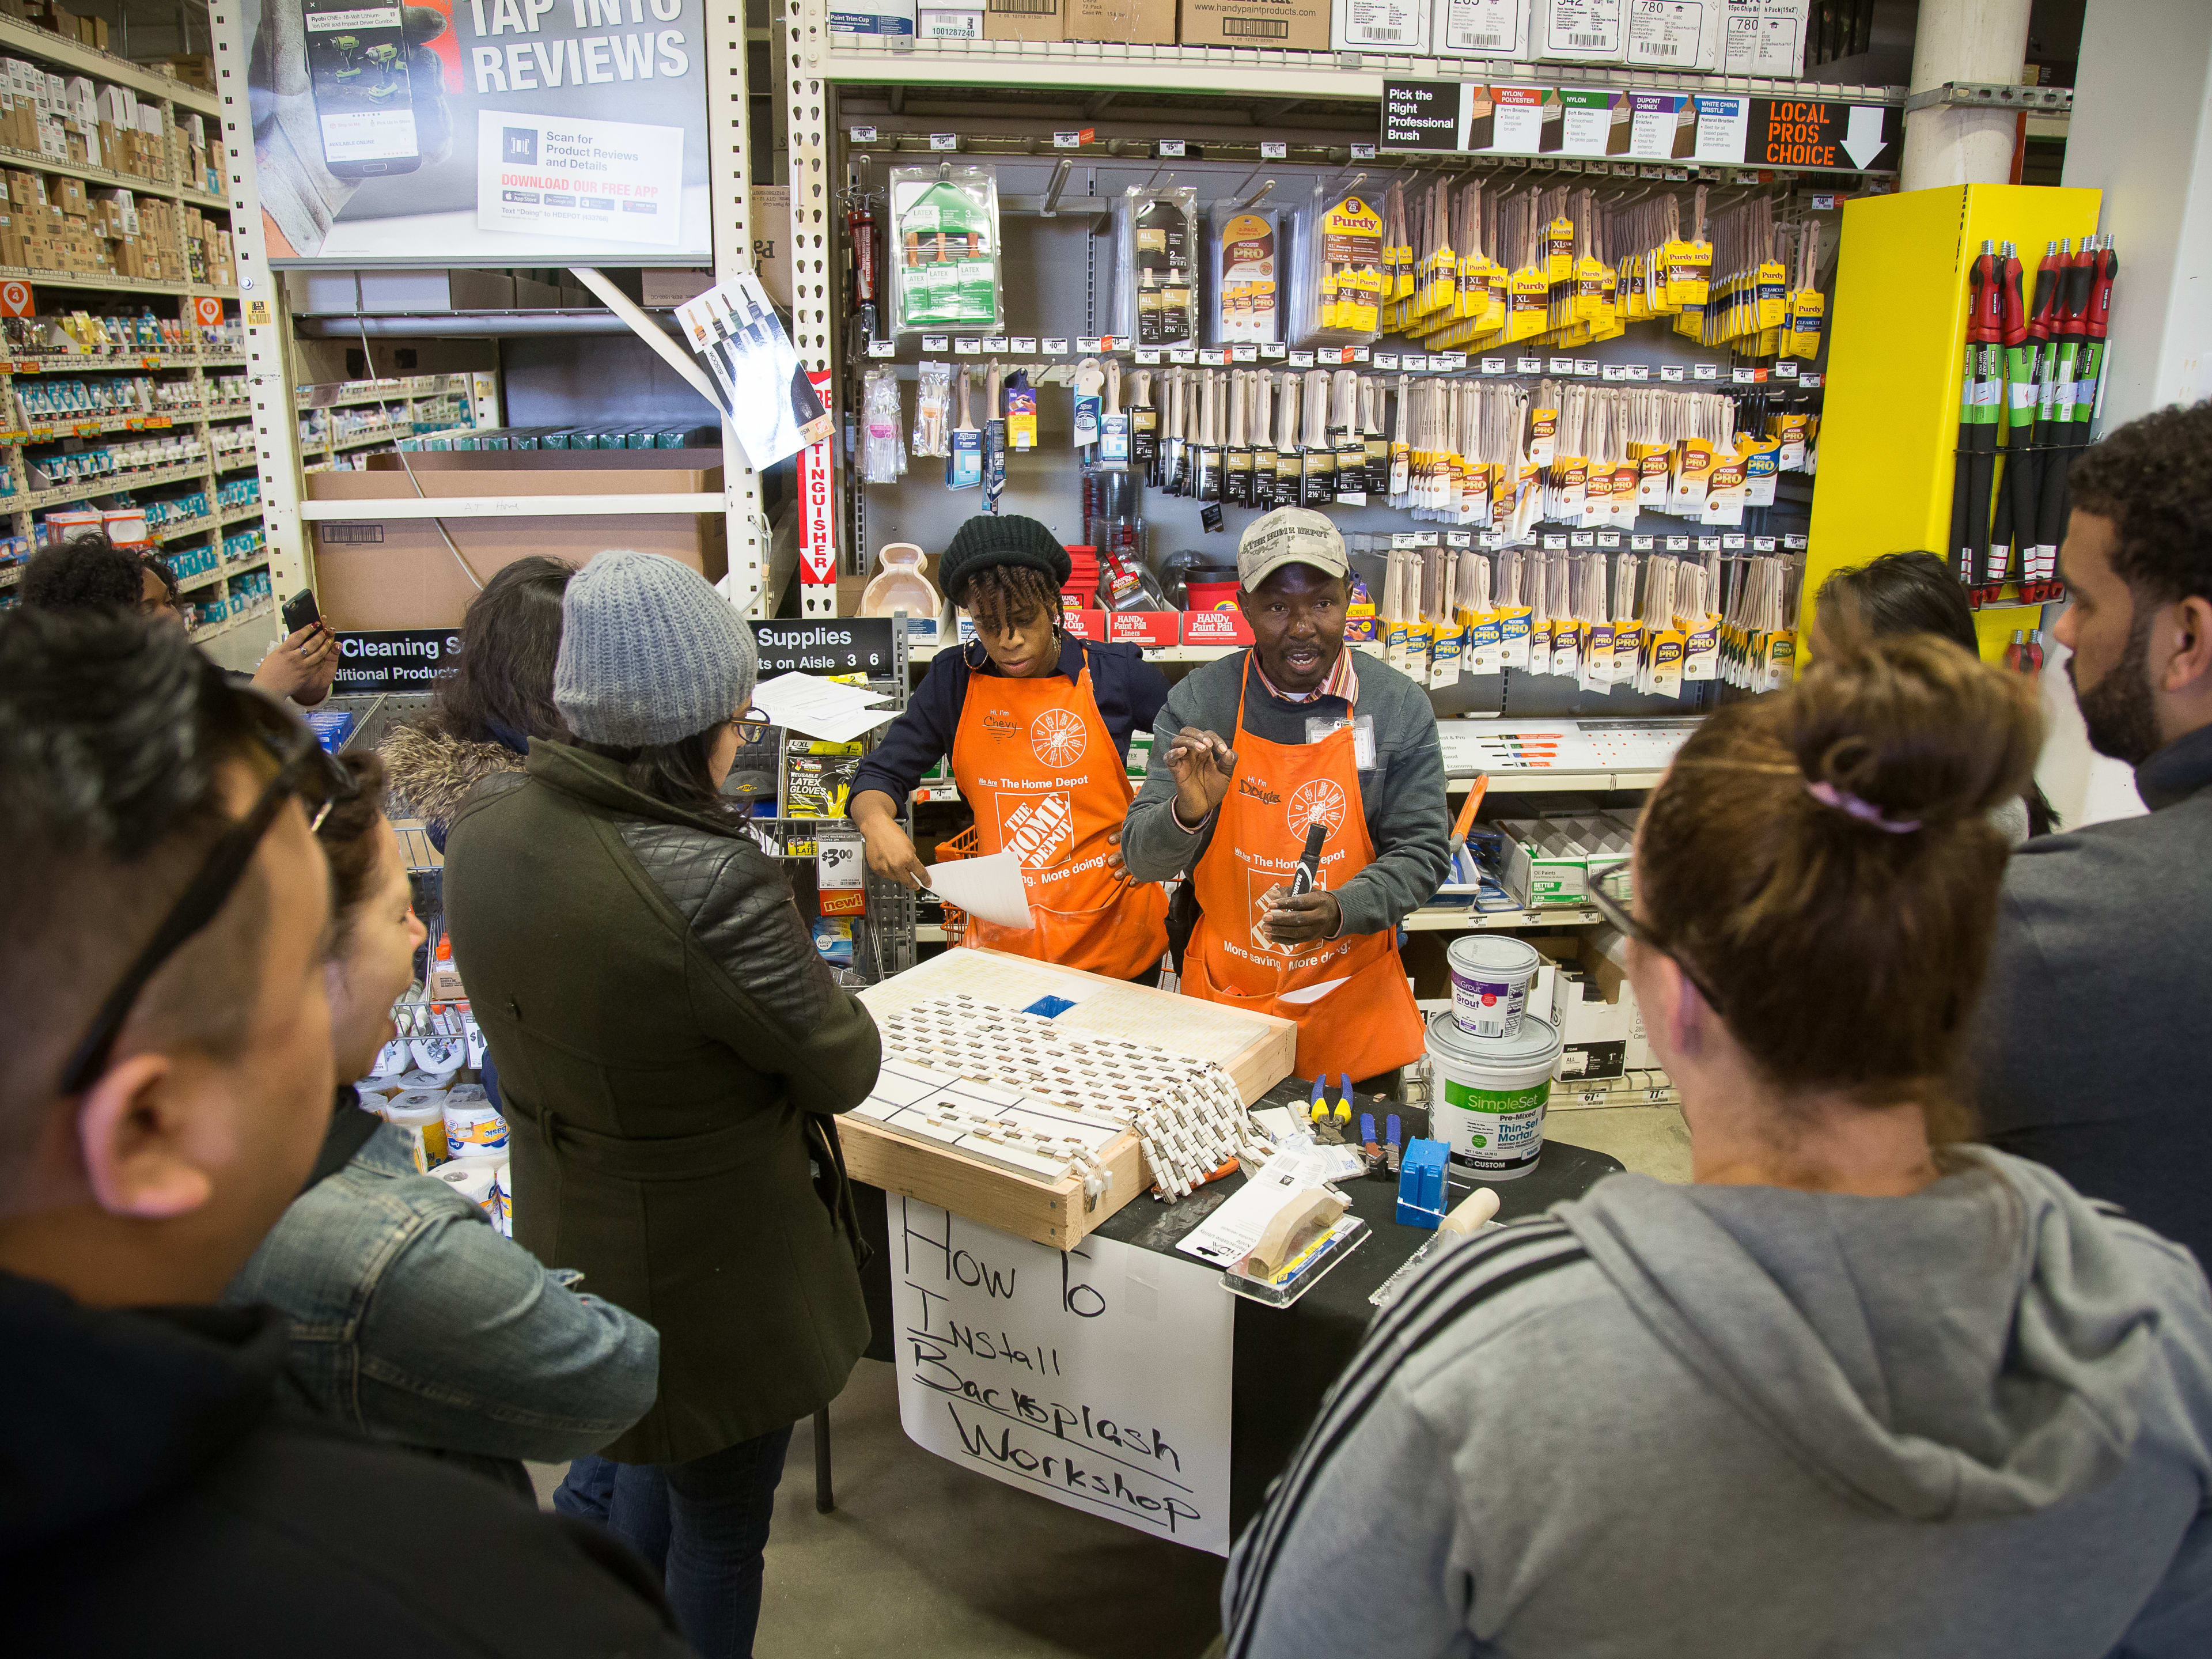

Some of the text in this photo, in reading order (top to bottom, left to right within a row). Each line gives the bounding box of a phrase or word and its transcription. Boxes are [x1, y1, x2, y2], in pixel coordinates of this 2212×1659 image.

[1194, 3, 1316, 16] www.handypaintproducts.com
[1642, 2, 1663, 13] 780
[1737, 20, 1758, 31] 780
[932, 28, 975, 37] 1001287240
[472, 30, 689, 93] REVIEWS
[1389, 89, 1433, 101] Pick the
[1389, 102, 1417, 115] Right
[1770, 101, 1830, 123] LOCAL
[1389, 116, 1454, 128] Professional
[547, 131, 593, 144] Scan for
[1388, 129, 1419, 140] Brush
[1768, 122, 1819, 143] PROS
[547, 145, 638, 161] Product Reviews
[1767, 143, 1835, 165] CHOICE
[546, 158, 607, 171] and Details
[502, 174, 658, 198] DOWNLOAD OUR FREE APP
[1332, 215, 1377, 230] Purdy
[1234, 248, 1264, 258] PRO
[1341, 288, 1354, 297] XL
[1517, 282, 1546, 291] Purdy
[12, 291, 20, 301] 4
[1359, 291, 1372, 299] XL
[709, 351, 724, 375] WOOSTER
[1642, 461, 1668, 471] PRO
[1748, 460, 1774, 471] PRO
[1463, 480, 1487, 490] PRO
[1588, 482, 1612, 492] PRO
[810, 437, 827, 569] TINGUISHER
[1248, 526, 1330, 550] THE HOME DEPOT
[1118, 615, 1144, 624] HANDy
[1196, 613, 1230, 624] HANDy
[1192, 622, 1233, 632] Paint Pail
[758, 627, 852, 649] Supplies
[342, 638, 439, 660] Cleaning
[776, 660, 795, 669] on
[799, 656, 835, 669] Aisle
[847, 654, 857, 666] 3
[869, 653, 879, 665] 6
[334, 667, 388, 681] ditional
[984, 716, 1017, 738] Chevy
[1000, 778, 1020, 789] The
[1022, 779, 1052, 789] Home
[1055, 775, 1088, 788] Depot
[1248, 775, 1267, 787] Hi, I'm
[790, 786, 826, 794] GLOVES
[1005, 802, 1034, 832] THE
[1003, 793, 1070, 863] HOME
[1028, 818, 1074, 869] DEPOT
[1234, 847, 1346, 870] We Are The Hom epot
[1041, 869, 1070, 884] More
[1071, 854, 1106, 874] doing.
[825, 895, 861, 911] new!
[1224, 940, 1248, 959] More
[1249, 953, 1281, 972] saving.
[1288, 955, 1318, 972] More
[1456, 987, 1474, 998] Pre-Mixed
[1456, 993, 1479, 1008] Grout
[1468, 1094, 1537, 1112] SimpleSet
[1500, 1110, 1536, 1121] Pre-Mixed
[484, 1124, 507, 1137] Basic
[1499, 1118, 1538, 1132] Thin-Set
[1498, 1130, 1533, 1142] Mortar
[903, 1195, 1016, 1300] How
[948, 1401, 1202, 1533] Workshop
